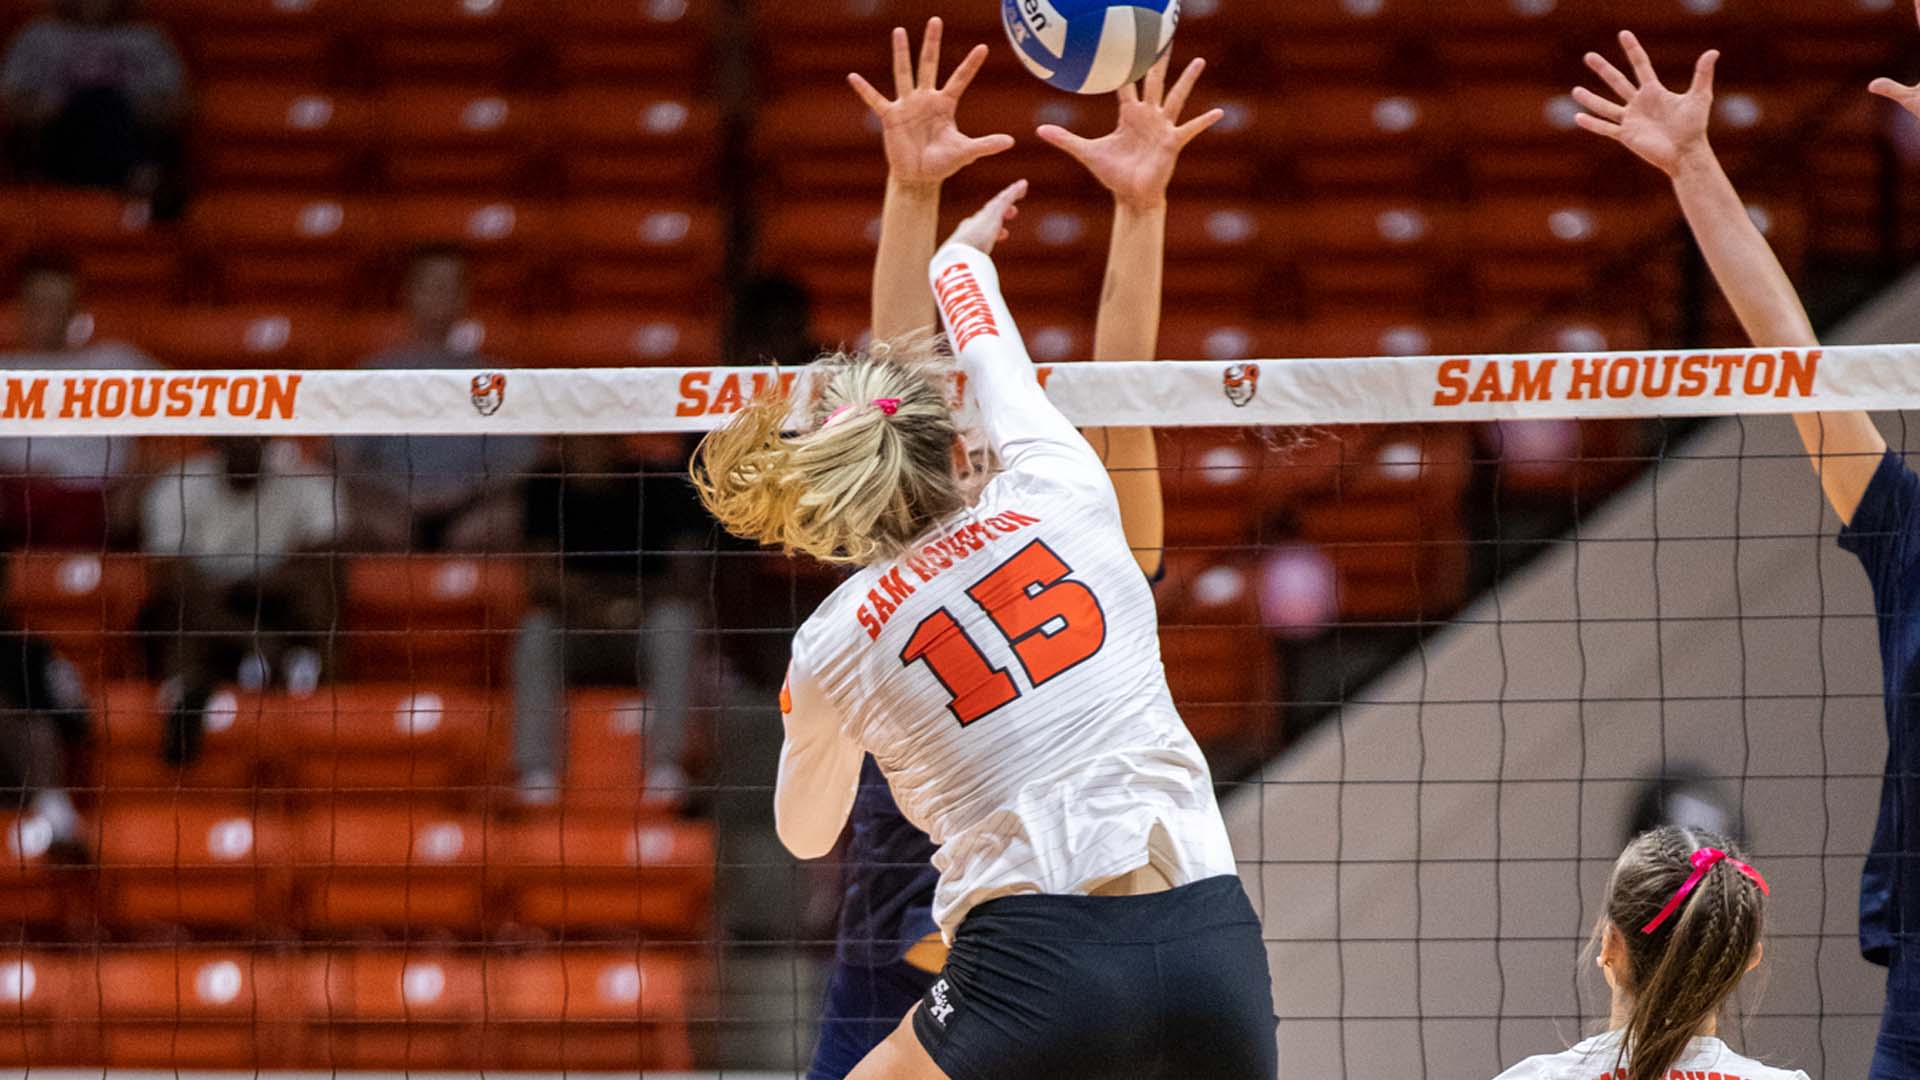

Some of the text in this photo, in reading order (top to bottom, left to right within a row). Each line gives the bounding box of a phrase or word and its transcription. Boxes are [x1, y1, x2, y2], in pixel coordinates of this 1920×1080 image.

[58, 375, 302, 419] HOUSTON
[1433, 351, 1822, 406] SAM HOUSTON
[856, 511, 1040, 641] SAM HOUSTON
[899, 537, 1107, 728] 15
